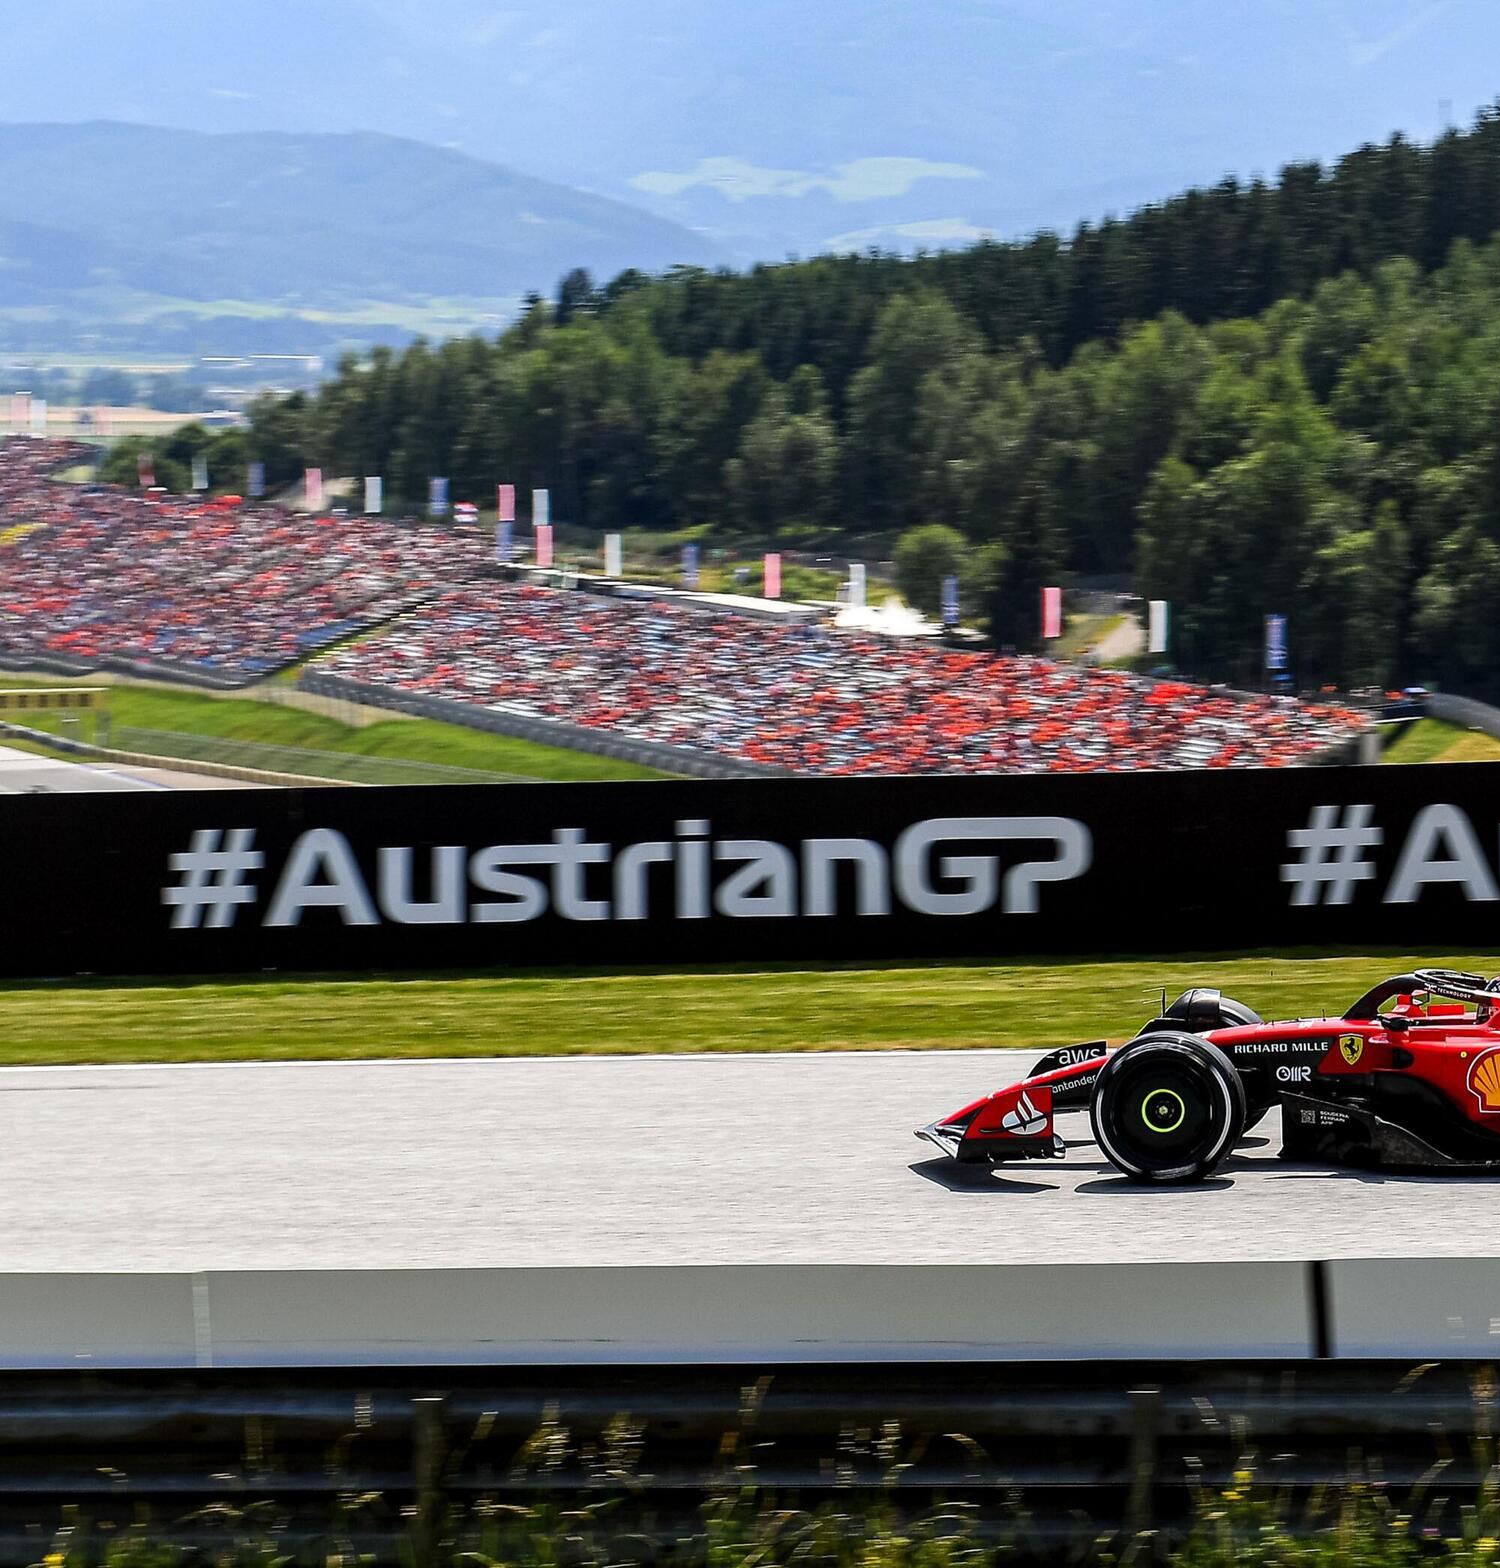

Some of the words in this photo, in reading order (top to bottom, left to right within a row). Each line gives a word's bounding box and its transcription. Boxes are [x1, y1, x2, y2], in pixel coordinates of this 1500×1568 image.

[163, 816, 1092, 930] #AustrianGP
[1437, 987, 1472, 999] TECHNOLOGY
[1058, 1048, 1101, 1065] aws
[1234, 1043, 1288, 1054] RICHARD
[1292, 1042, 1329, 1052] MILLE
[1052, 1074, 1097, 1094] antander
